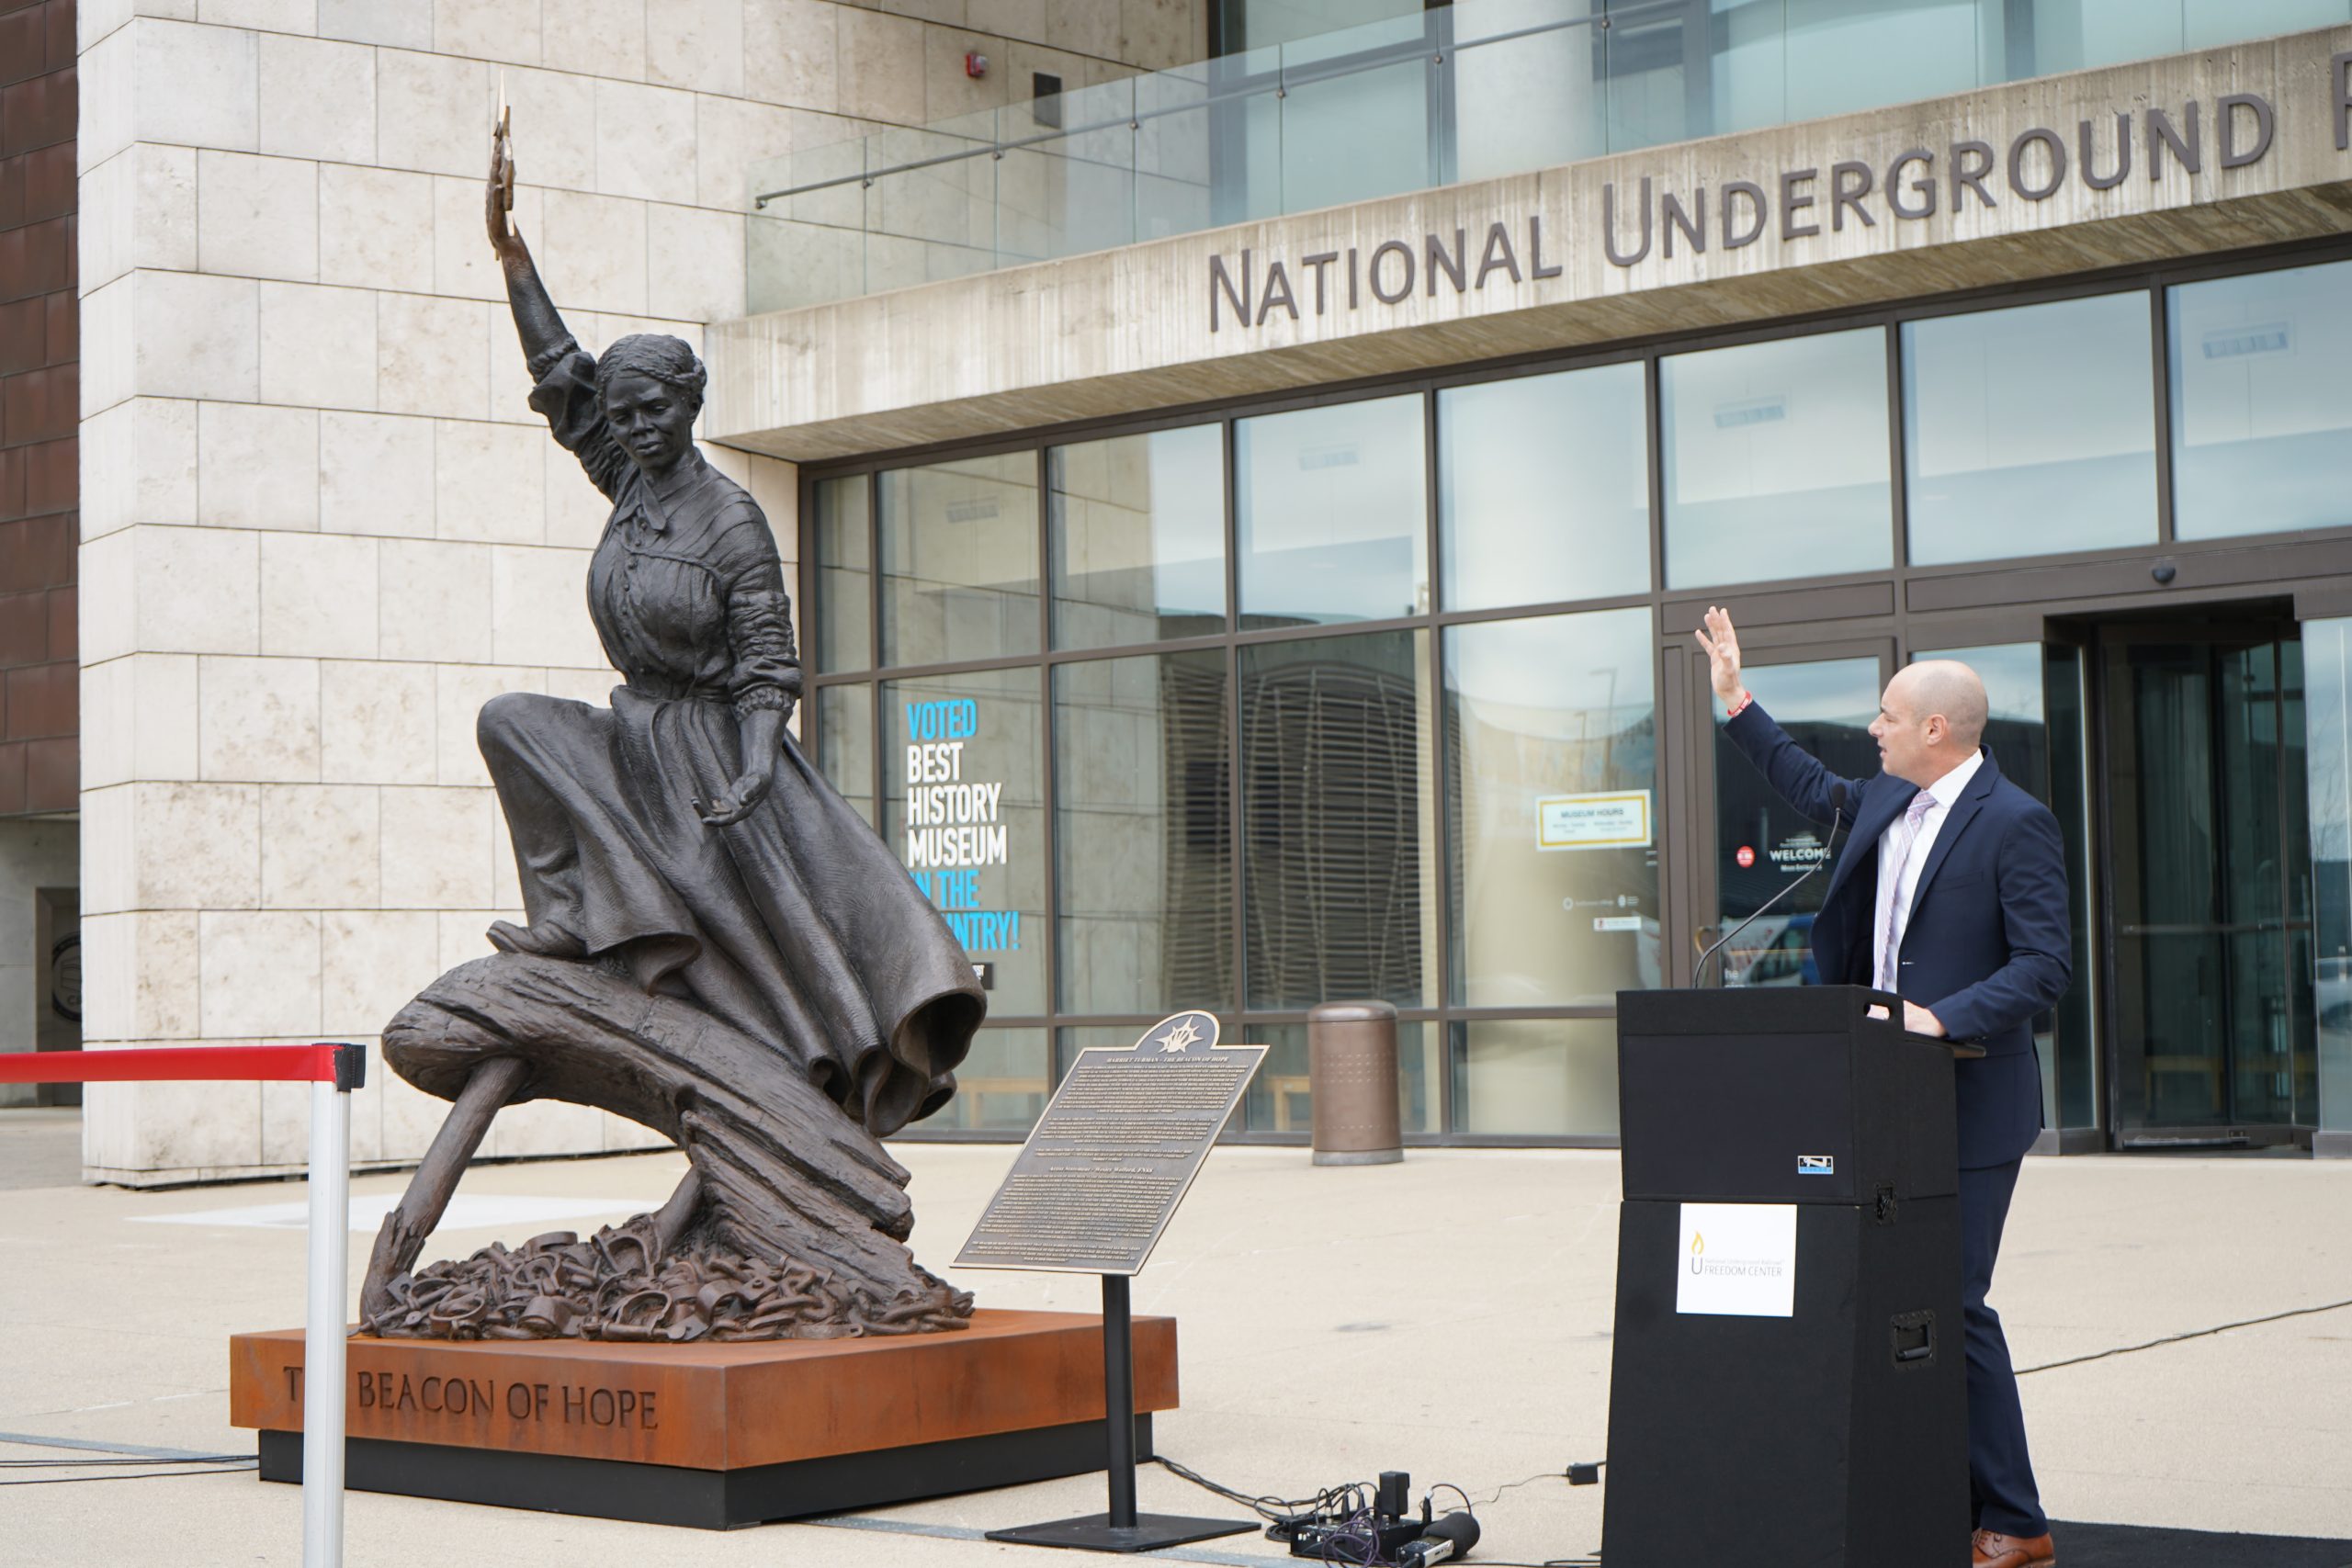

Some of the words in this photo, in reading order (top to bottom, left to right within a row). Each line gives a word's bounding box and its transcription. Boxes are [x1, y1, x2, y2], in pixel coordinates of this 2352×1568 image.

[1210, 216, 1563, 332] NATIONAL
[1604, 94, 2274, 267] UNDERGROUND
[906, 698, 977, 741] VOTED
[907, 742, 964, 784] BEST
[907, 783, 1001, 826] HISTORY
[1560, 809, 1595, 818] MUSEUM
[1596, 807, 1624, 817] HOURS
[907, 825, 1007, 868] MUSEUM
[909, 870, 932, 901] N
[936, 869, 979, 908] THE
[941, 910, 1020, 952] NTRY!
[1704, 1265, 1746, 1276] FREEDOM
[1747, 1266, 1782, 1277] CENTER
[357, 1371, 494, 1416] BEACON
[506, 1382, 549, 1422] OF
[561, 1385, 659, 1429] HOPE
